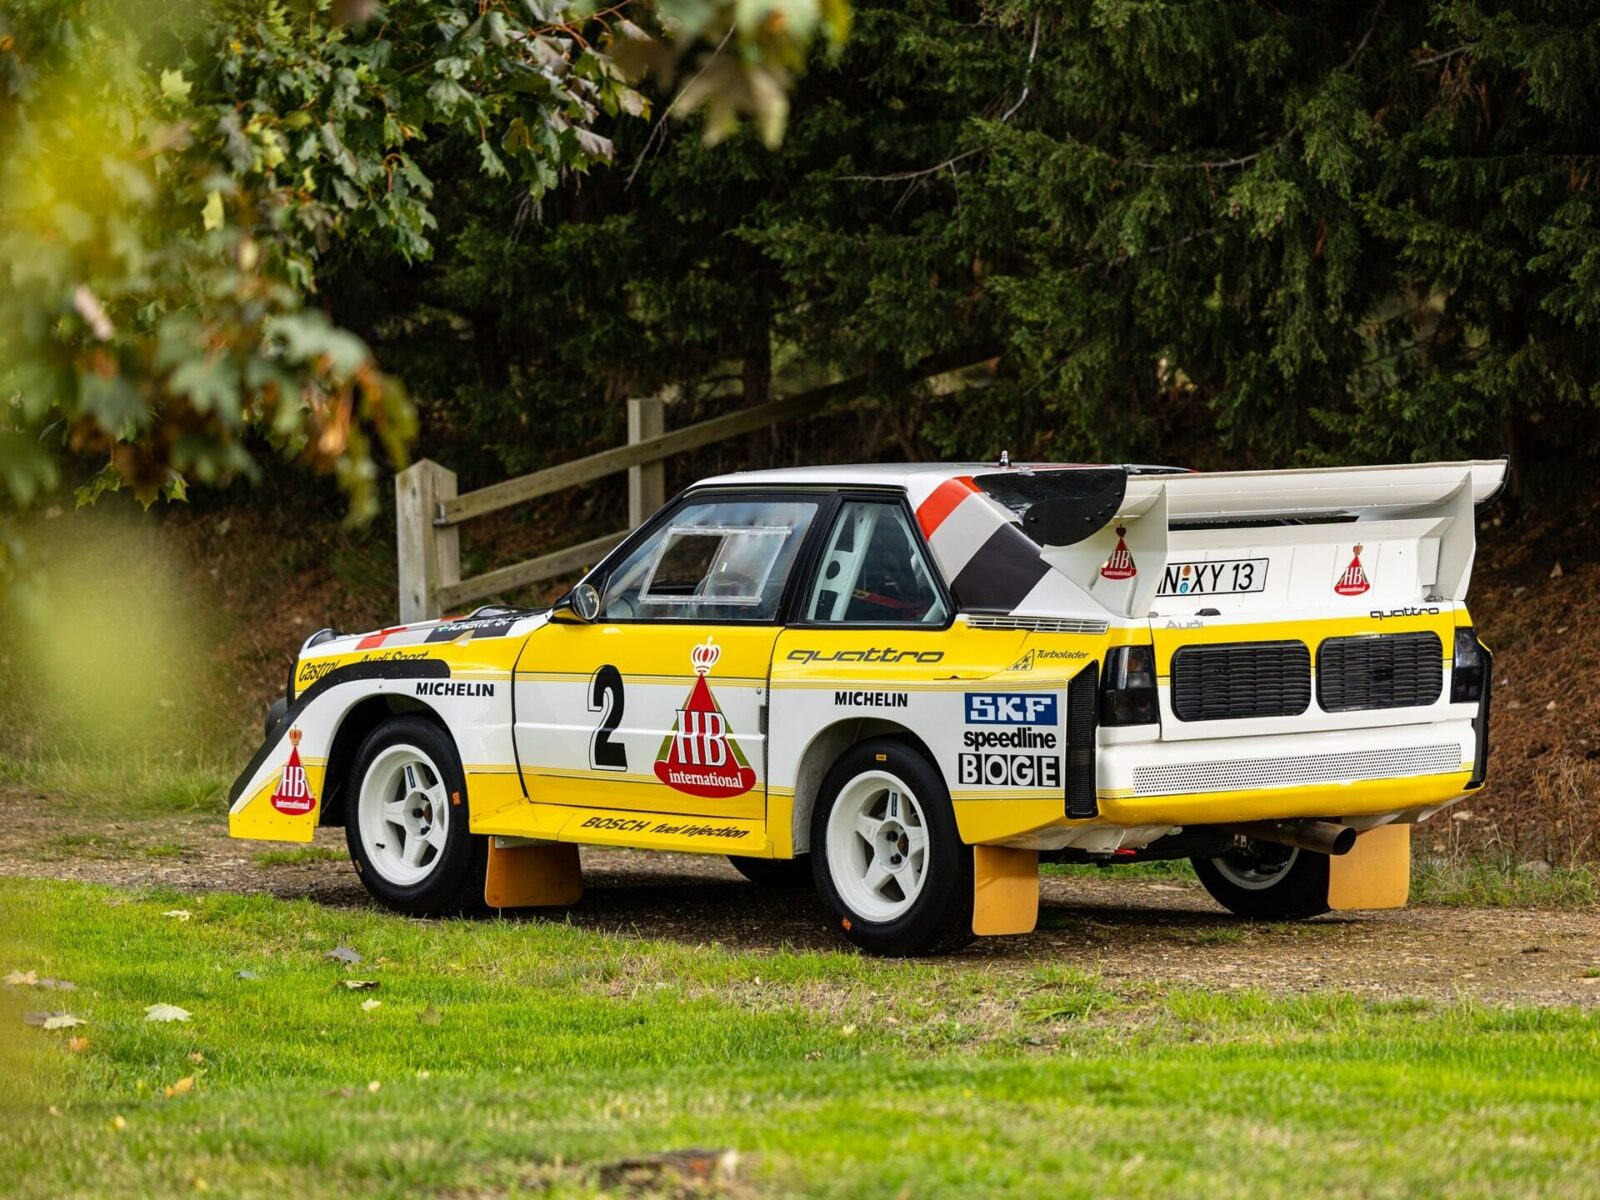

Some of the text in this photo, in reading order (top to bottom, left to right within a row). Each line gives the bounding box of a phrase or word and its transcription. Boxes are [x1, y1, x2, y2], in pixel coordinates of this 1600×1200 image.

[1110, 550, 1130, 568] HB
[1232, 563, 1254, 591] 13
[1344, 566, 1363, 585] HB
[1370, 606, 1440, 621] quattro
[1165, 620, 1204, 631] Audi
[787, 647, 945, 664] quattro
[1037, 649, 1090, 659] Turbolader
[416, 682, 494, 697] MICHELIN
[834, 691, 909, 707] MICHELIN
[588, 664, 629, 773] 2
[970, 696, 1052, 722] SKF
[675, 709, 727, 767] HB
[963, 727, 1057, 751] speedline
[668, 769, 744, 789] international
[959, 753, 1060, 787] BOGE
[282, 766, 306, 797] HB
[580, 816, 750, 838] BOSCH fuel injection
